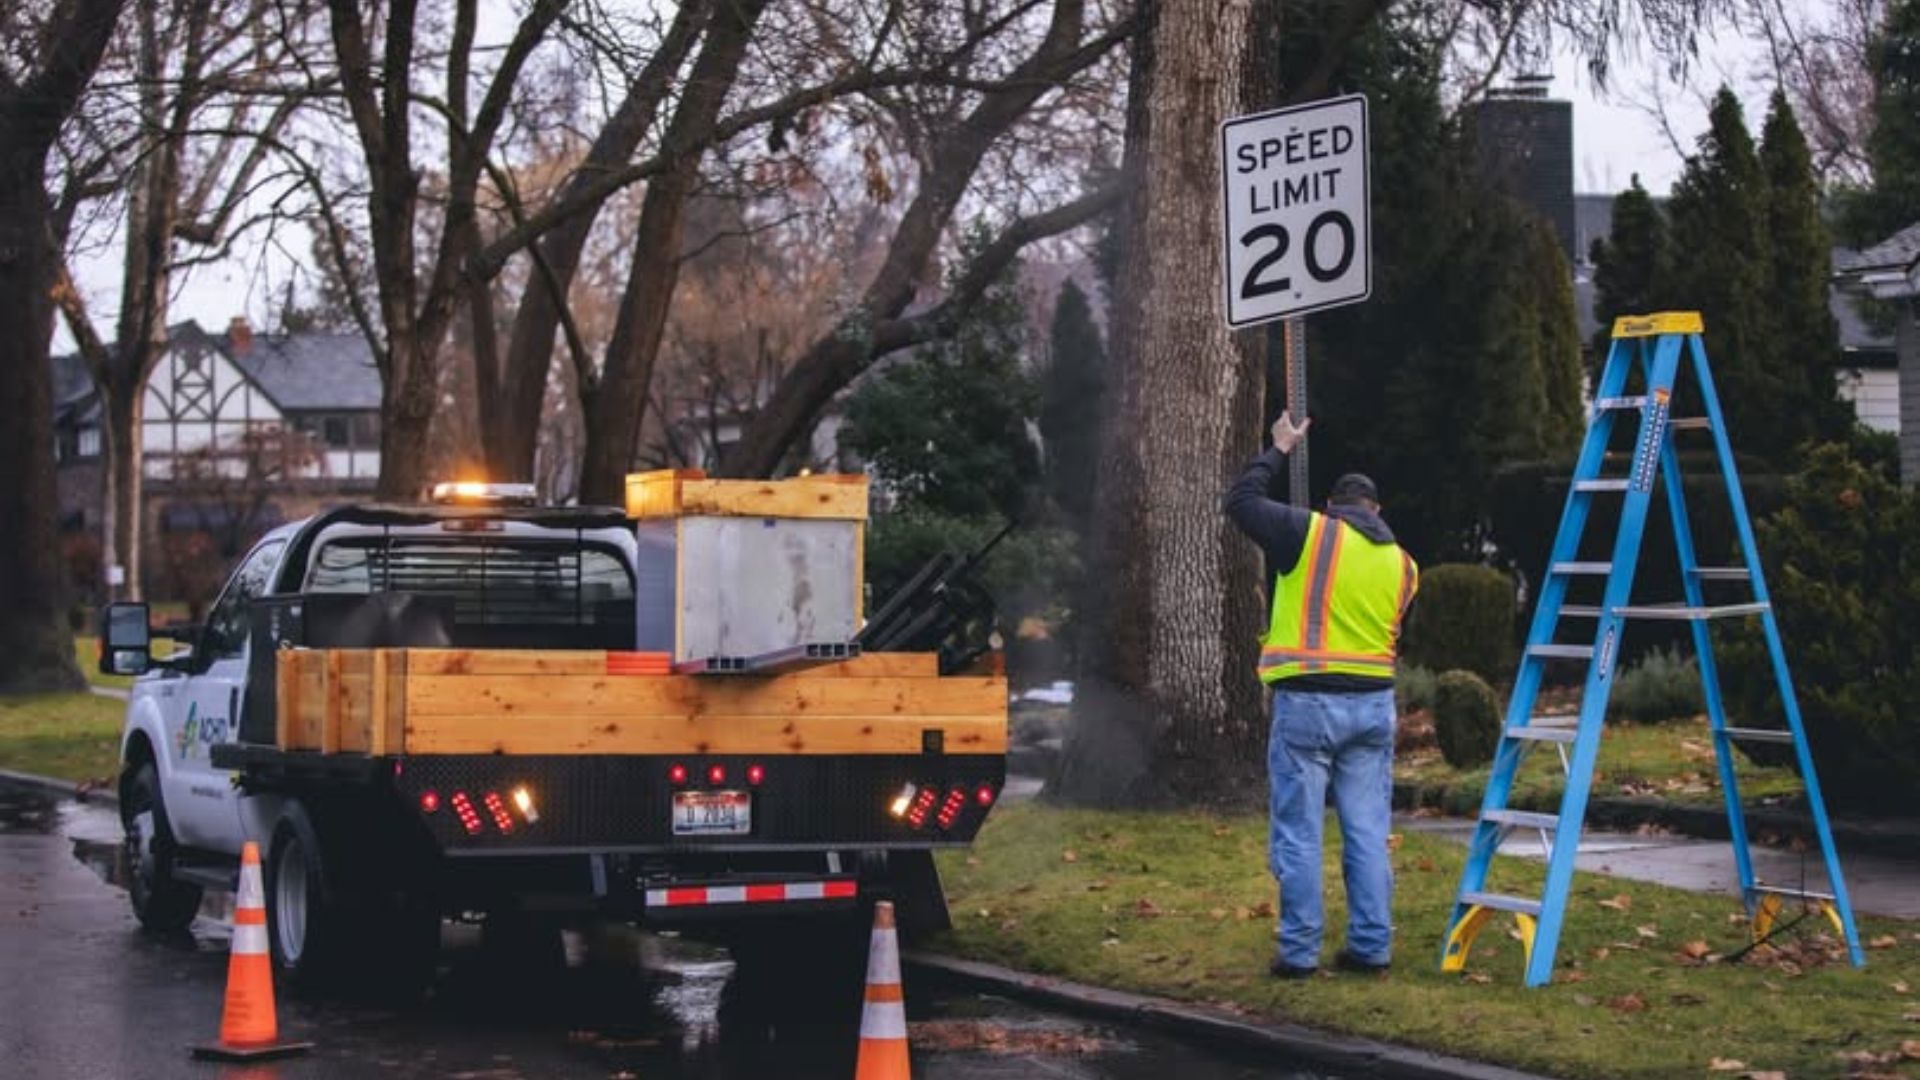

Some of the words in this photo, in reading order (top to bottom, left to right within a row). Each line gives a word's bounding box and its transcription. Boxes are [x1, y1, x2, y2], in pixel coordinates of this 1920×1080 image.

[1237, 125, 1354, 174] SPEED
[1251, 168, 1342, 214] LIMIT
[1240, 210, 1356, 300] 20
